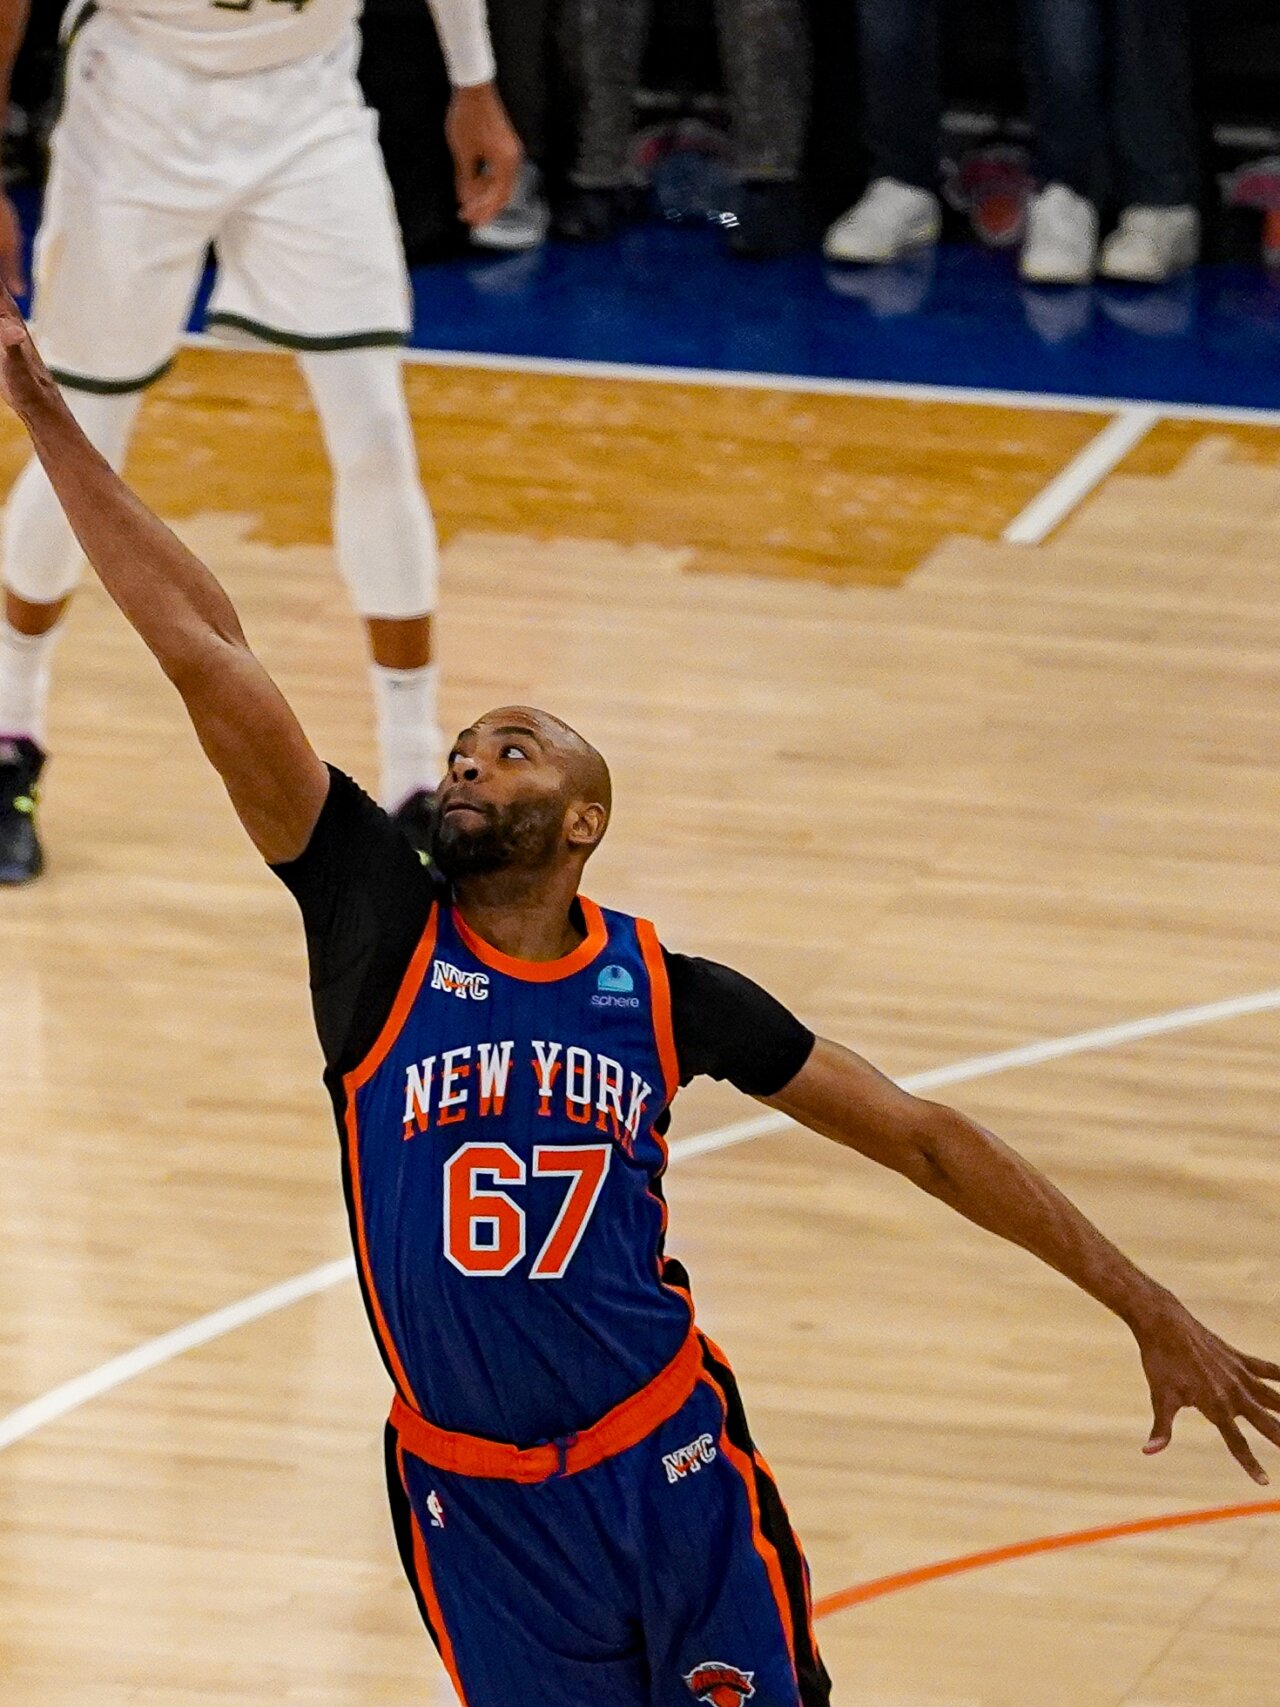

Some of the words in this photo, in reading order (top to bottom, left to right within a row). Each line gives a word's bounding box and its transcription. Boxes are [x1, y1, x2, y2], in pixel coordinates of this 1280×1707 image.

[431, 960, 490, 1000] NYC
[403, 1041, 515, 1136] NEW
[531, 1041, 652, 1148] YORK
[443, 1142, 613, 1279] 67
[662, 1433, 717, 1483] NYC
